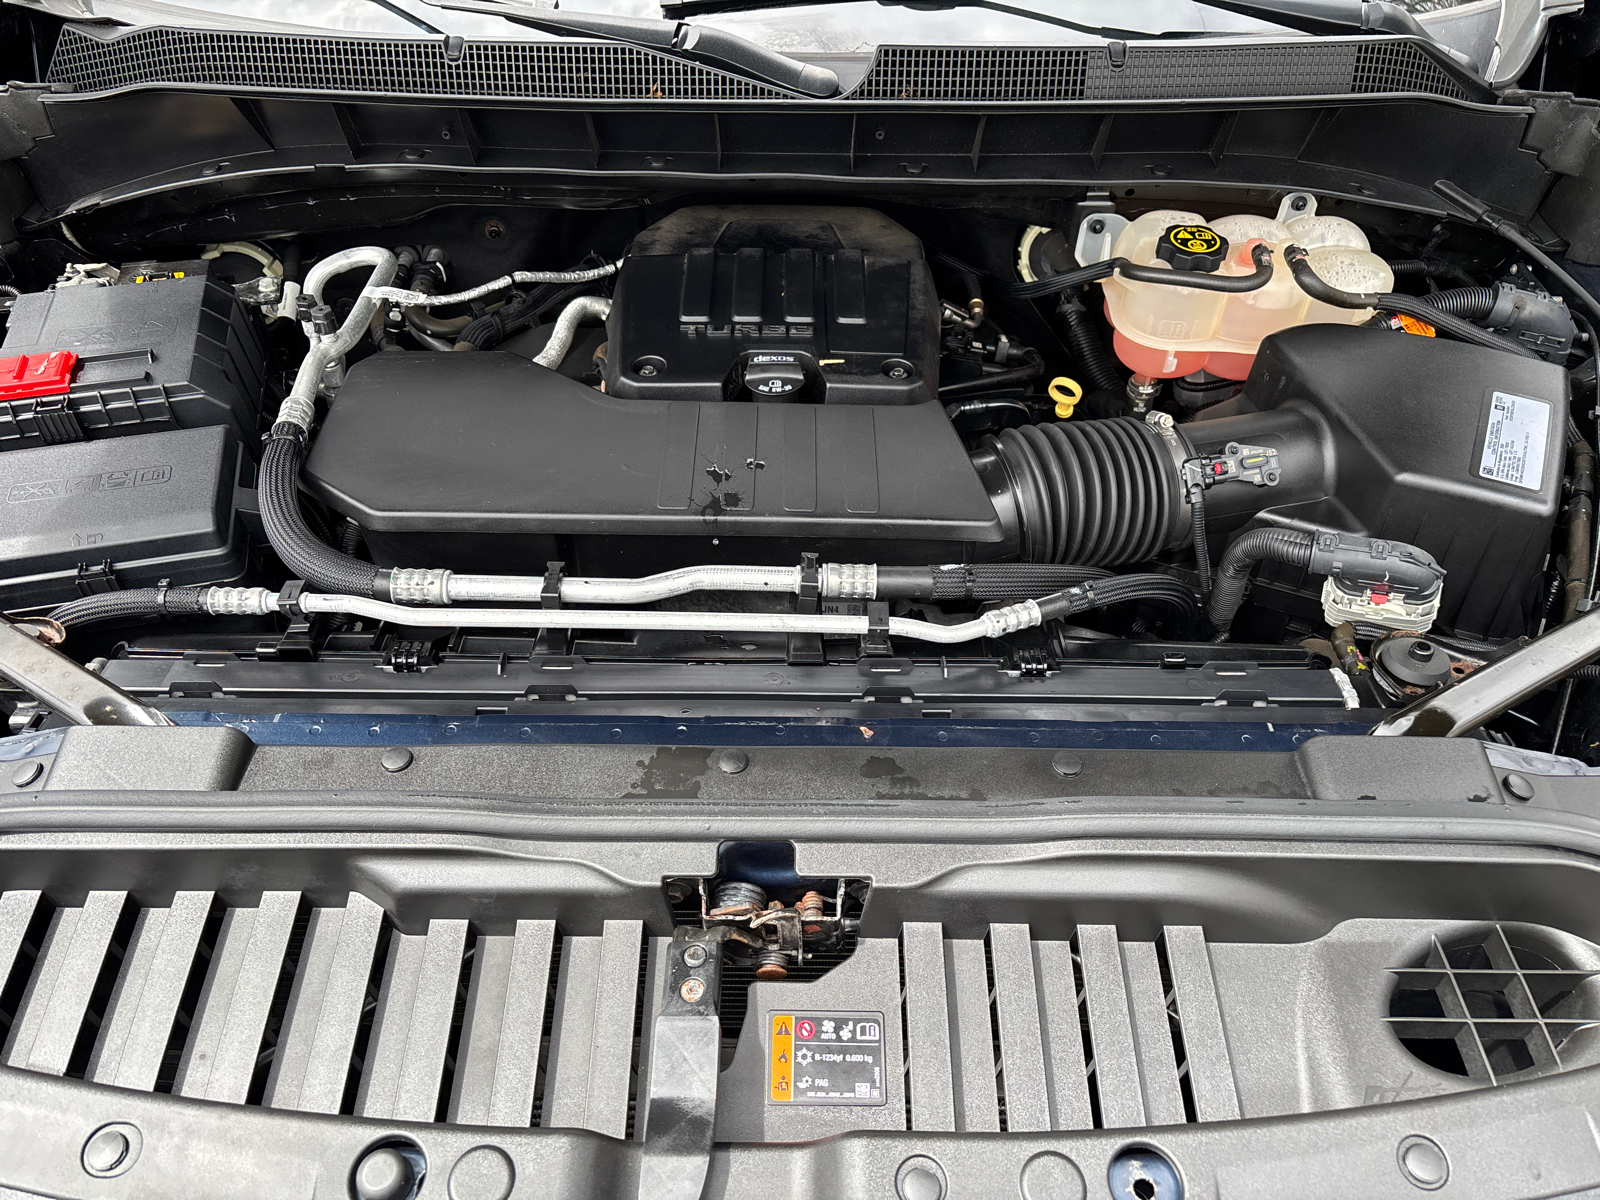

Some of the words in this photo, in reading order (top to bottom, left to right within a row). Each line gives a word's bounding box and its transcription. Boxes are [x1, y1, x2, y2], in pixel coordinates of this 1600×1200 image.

[679, 324, 814, 337] TURBO
[753, 354, 795, 363] dexos
[814, 1054, 843, 1063] R-1234yf
[864, 1054, 873, 1063] kg
[814, 1078, 829, 1087] PAG
